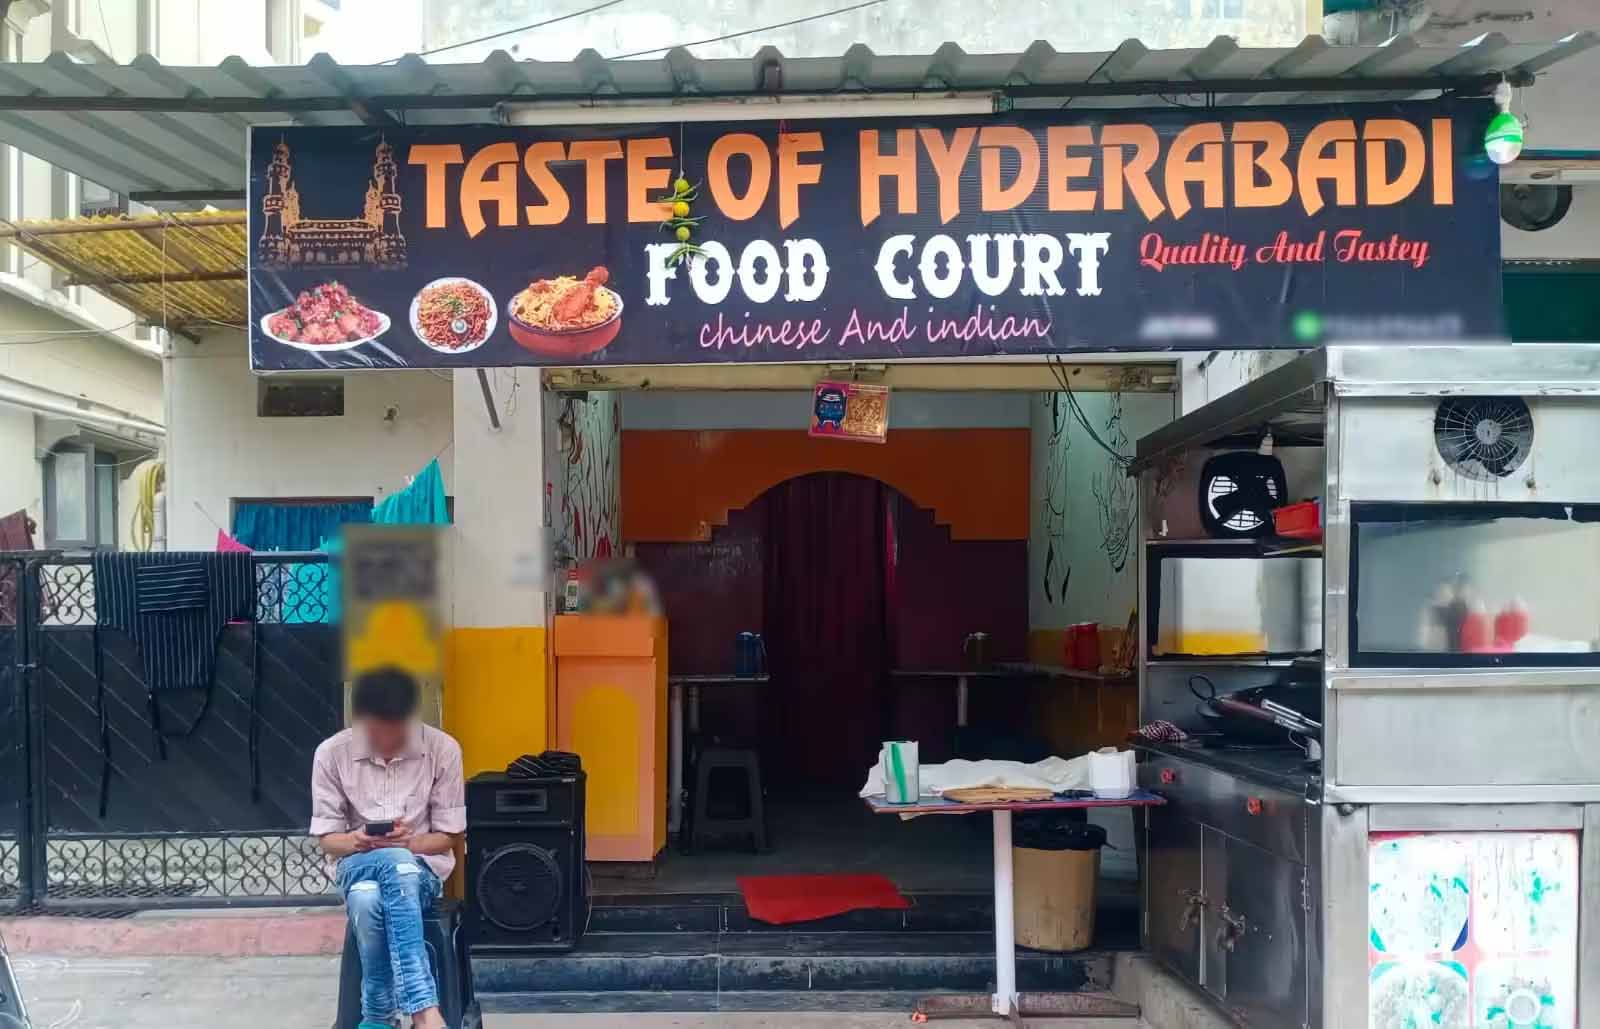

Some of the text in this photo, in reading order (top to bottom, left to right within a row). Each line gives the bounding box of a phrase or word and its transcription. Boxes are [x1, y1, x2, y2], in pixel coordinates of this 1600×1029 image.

[408, 118, 1454, 239] TASTE OF HYDERABADI
[644, 232, 1112, 306] FOOD COURT
[1139, 229, 1430, 273] Quality And Tastey
[700, 304, 1052, 350] chinese And indian
